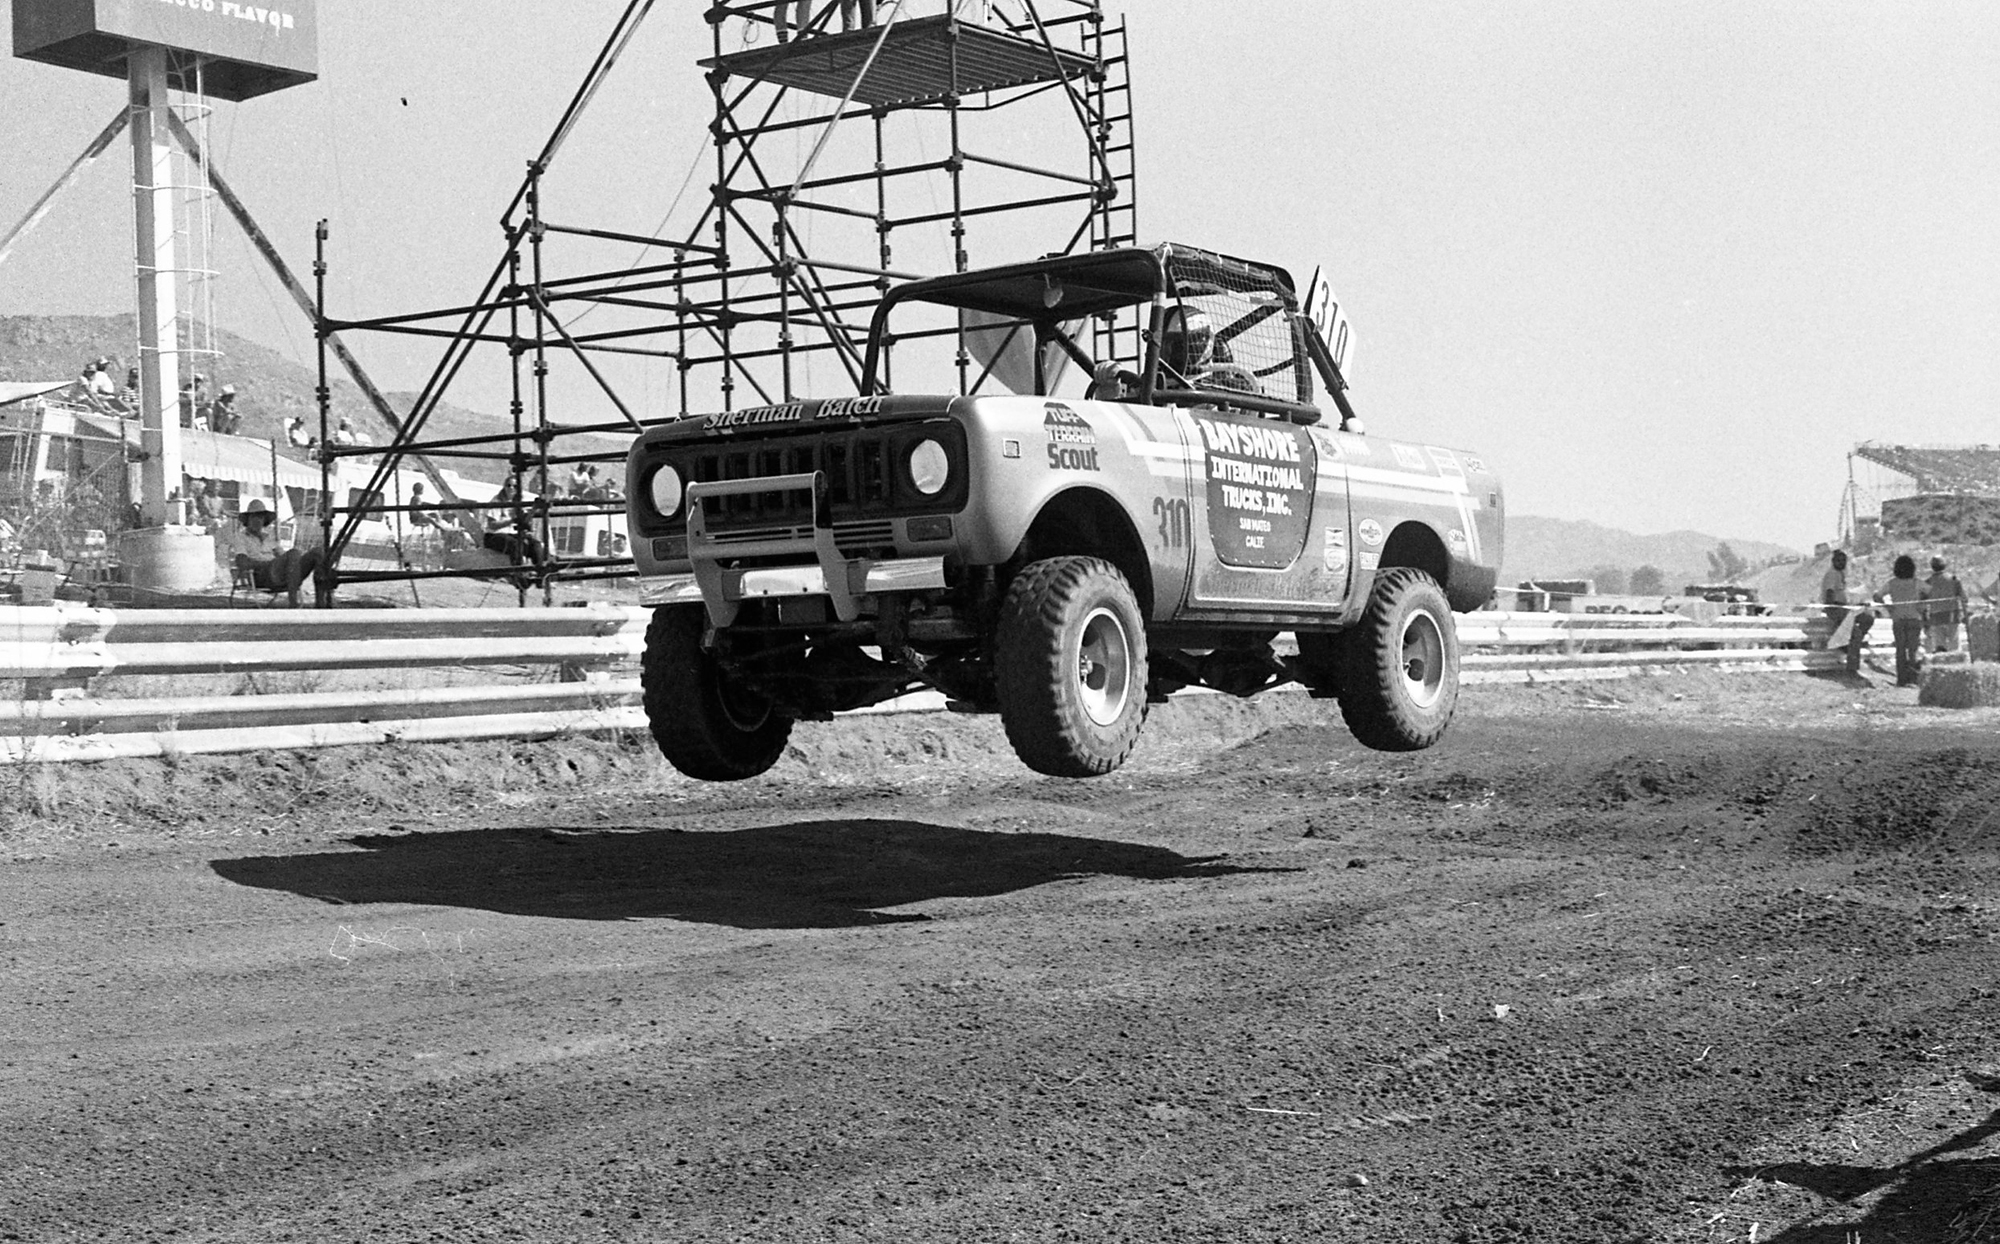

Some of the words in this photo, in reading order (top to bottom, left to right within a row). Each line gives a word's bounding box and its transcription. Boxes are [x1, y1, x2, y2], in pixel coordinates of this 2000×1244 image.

[221, 1, 294, 30] FLAVOR
[1315, 280, 1348, 370] 310
[1048, 406, 1083, 423] TUFF
[1044, 424, 1096, 444] TERRAIN
[1199, 418, 1300, 462] BAYSHORE
[1047, 443, 1100, 471] Scout
[1211, 455, 1304, 490] INTERNATIONAL
[1153, 496, 1190, 549] 310
[1239, 517, 1252, 530] SAN
[1252, 519, 1271, 532] MATEO
